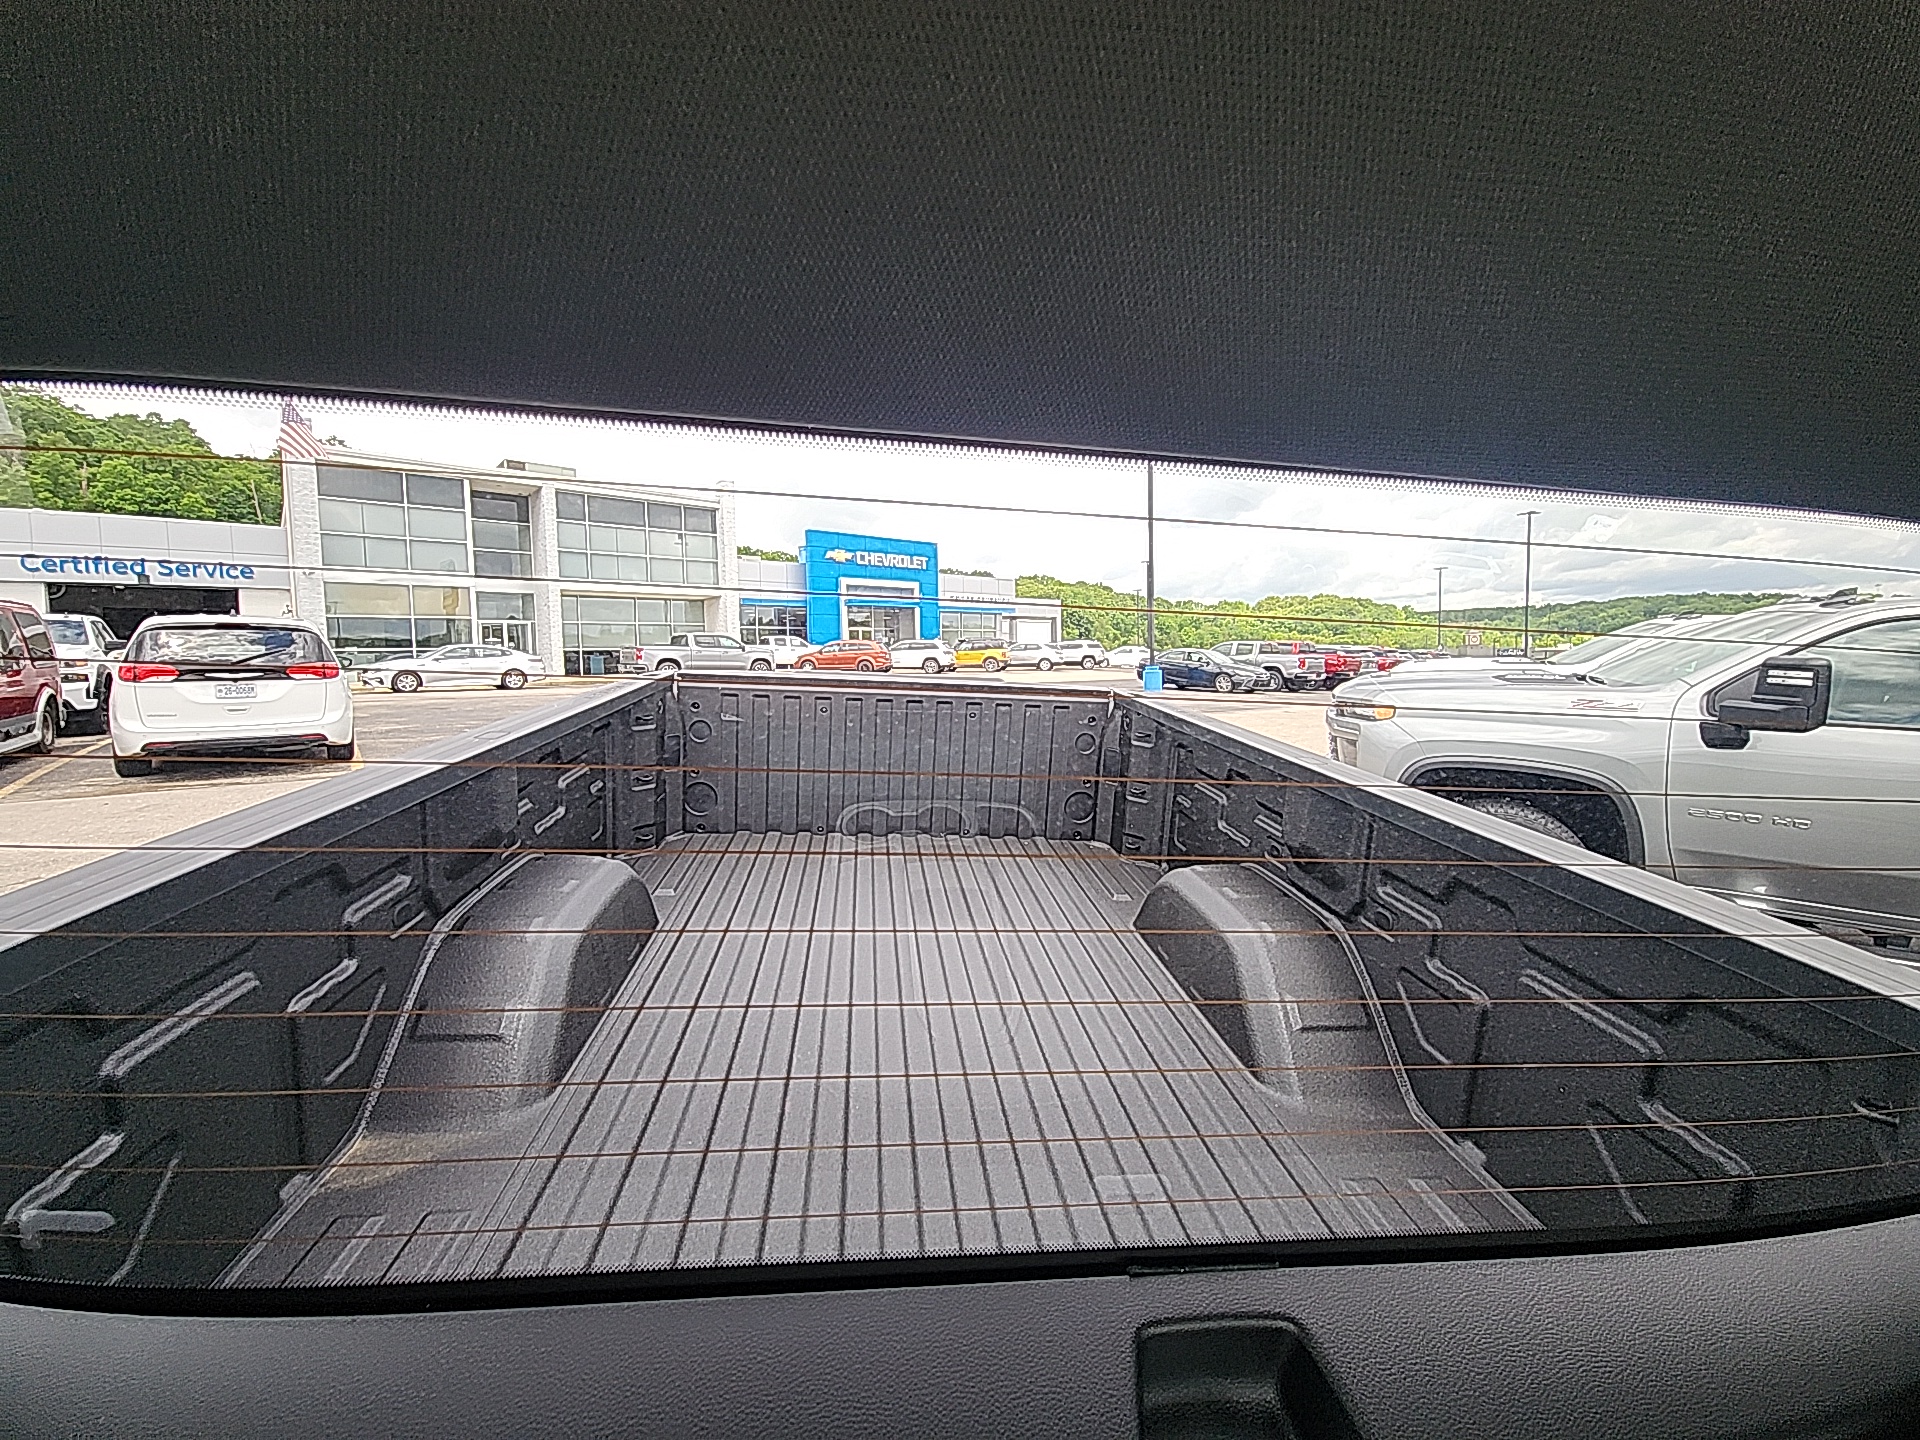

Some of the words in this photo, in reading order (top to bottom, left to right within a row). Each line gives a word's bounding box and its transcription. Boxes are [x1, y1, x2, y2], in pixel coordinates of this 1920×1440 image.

[19, 553, 146, 576] Certified
[157, 559, 255, 580] Service
[855, 551, 928, 569] CHEVROLET
[1687, 806, 1763, 824] 2500
[1770, 815, 1813, 830] HD
